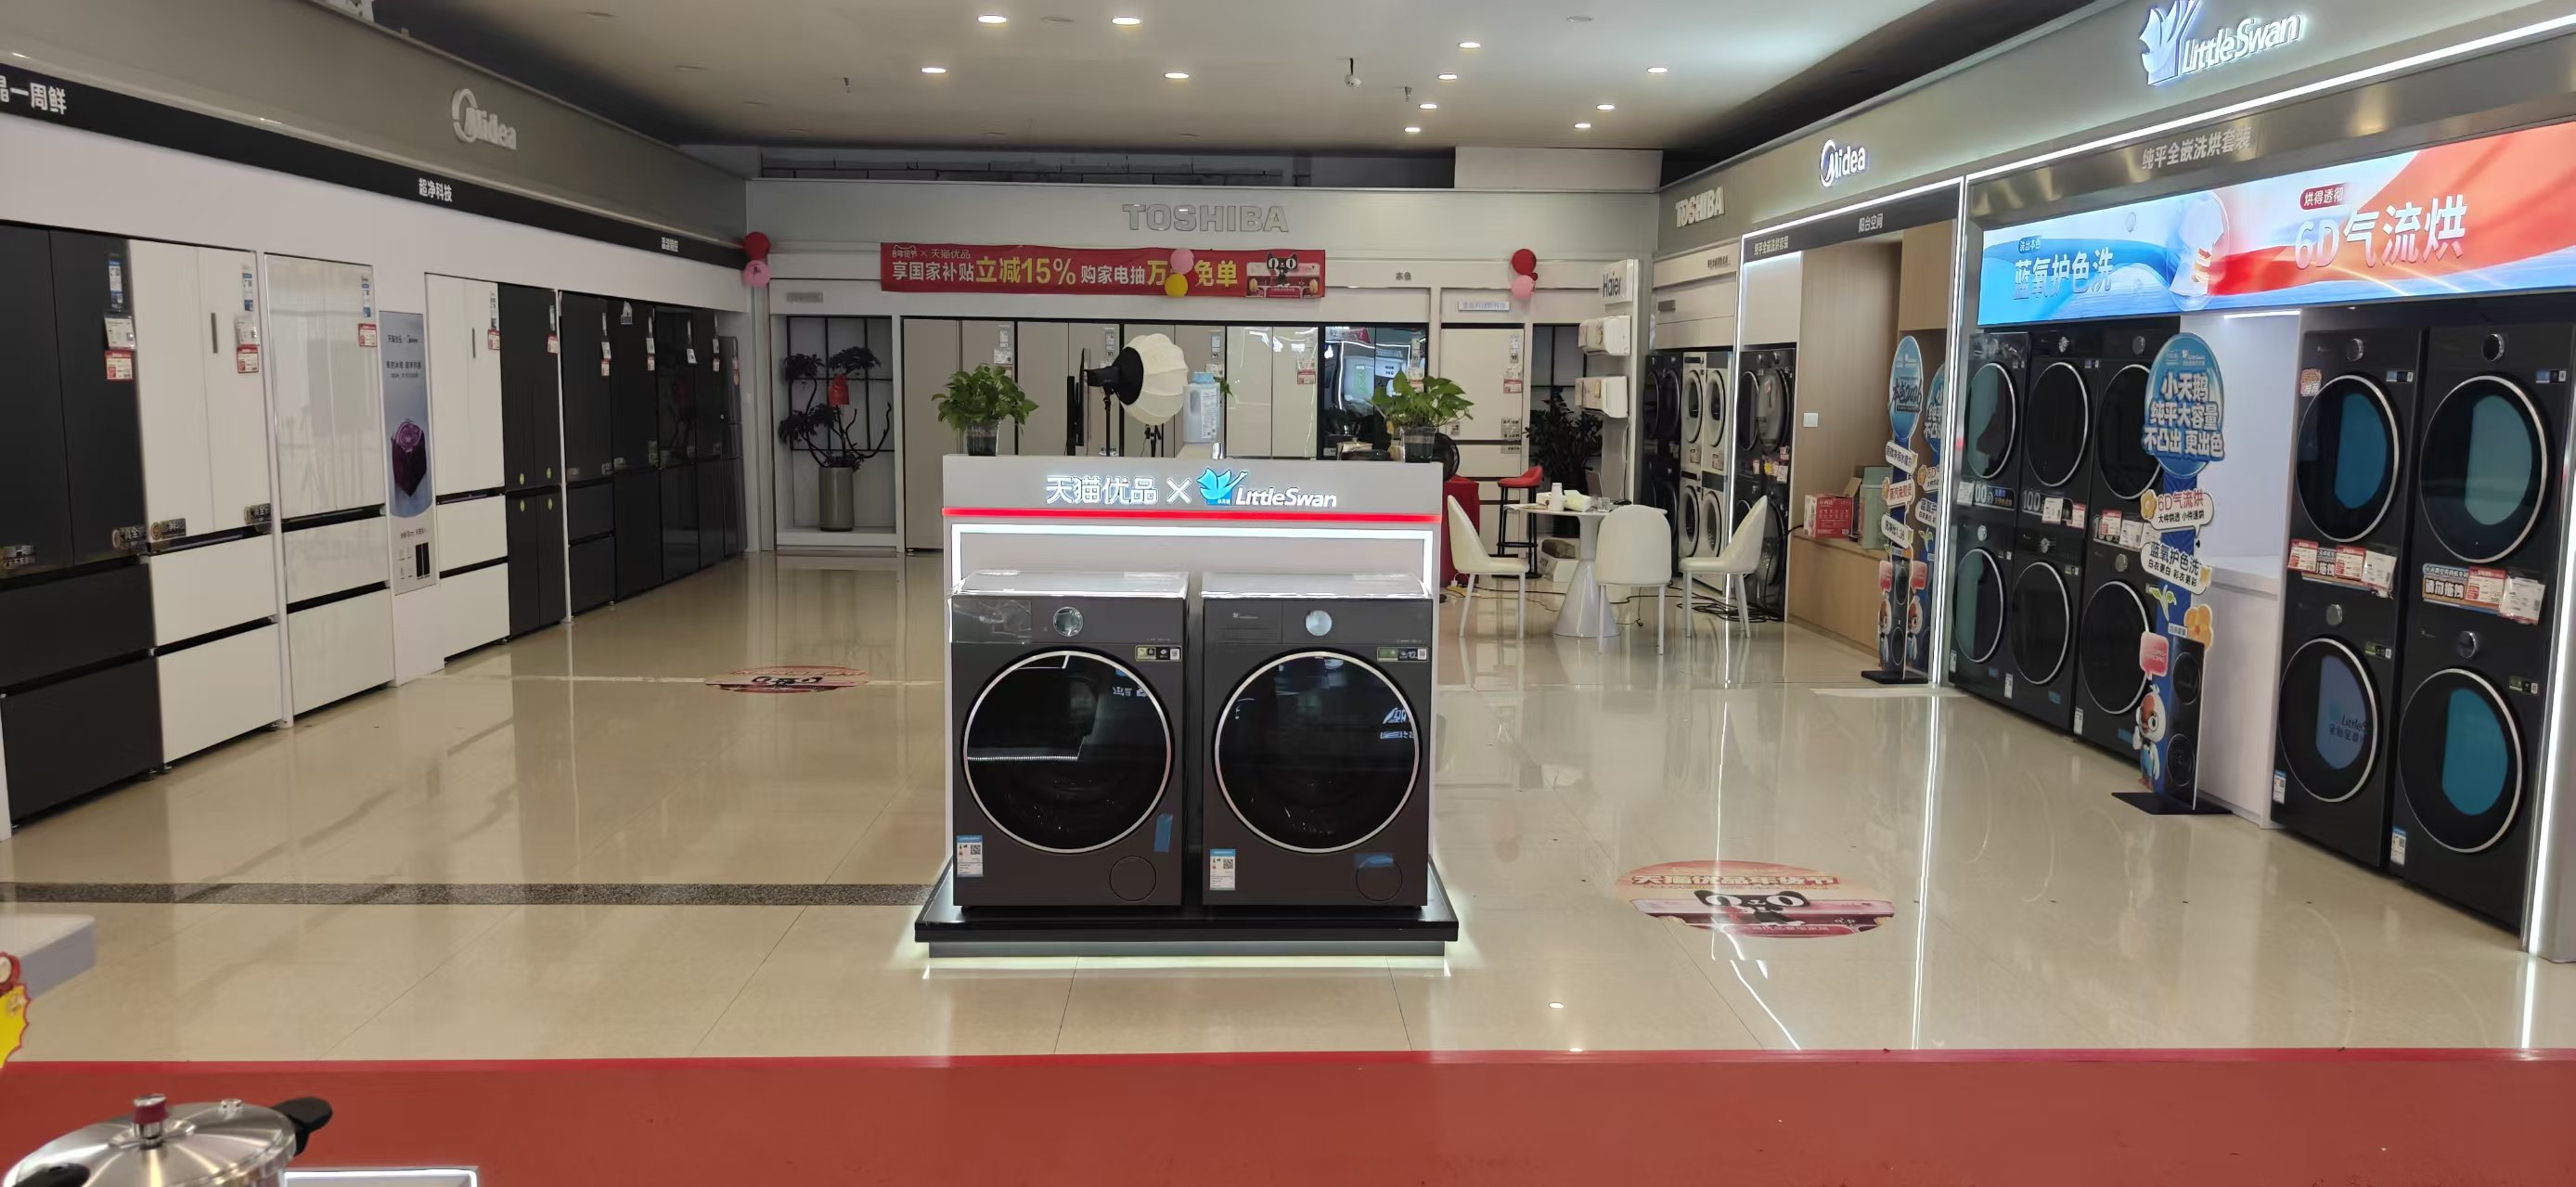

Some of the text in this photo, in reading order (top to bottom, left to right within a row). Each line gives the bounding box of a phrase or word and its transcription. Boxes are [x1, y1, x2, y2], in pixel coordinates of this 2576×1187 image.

[2183, 14, 2303, 73] LittleSwan
[452, 88, 517, 149] Midea
[1820, 139, 1867, 187] Midea
[2142, 126, 2252, 169] 纯平全嵌洗烘套装
[419, 178, 453, 202] 超净科技
[2304, 187, 2344, 207] 烘得透彻
[1122, 203, 1290, 233] TOSHIBA
[1675, 187, 1725, 227] TOSHIBA
[1859, 213, 1884, 233] 阳台空间
[2294, 194, 2468, 269] 6D气流烘
[931, 249, 971, 259] 天猫优品
[1603, 271, 1621, 297] Haier
[2013, 246, 2113, 300] 蓝氧护色洗
[2160, 370, 2209, 403] 小天鹅
[2150, 401, 2219, 432] 纯平大容量
[2144, 427, 2223, 458] 不凸出 更出色
[1046, 475, 1158, 505] 天猫优品
[1235, 486, 1337, 509] LittleSwan
[2157, 488, 2204, 511] 6D气流烘
[2148, 559, 2197, 587] 白衣更白 彩衣更彩
[2149, 541, 2199, 575] 蓝氧护色洗
[1631, 875, 1841, 885] 天猫优品年货节
